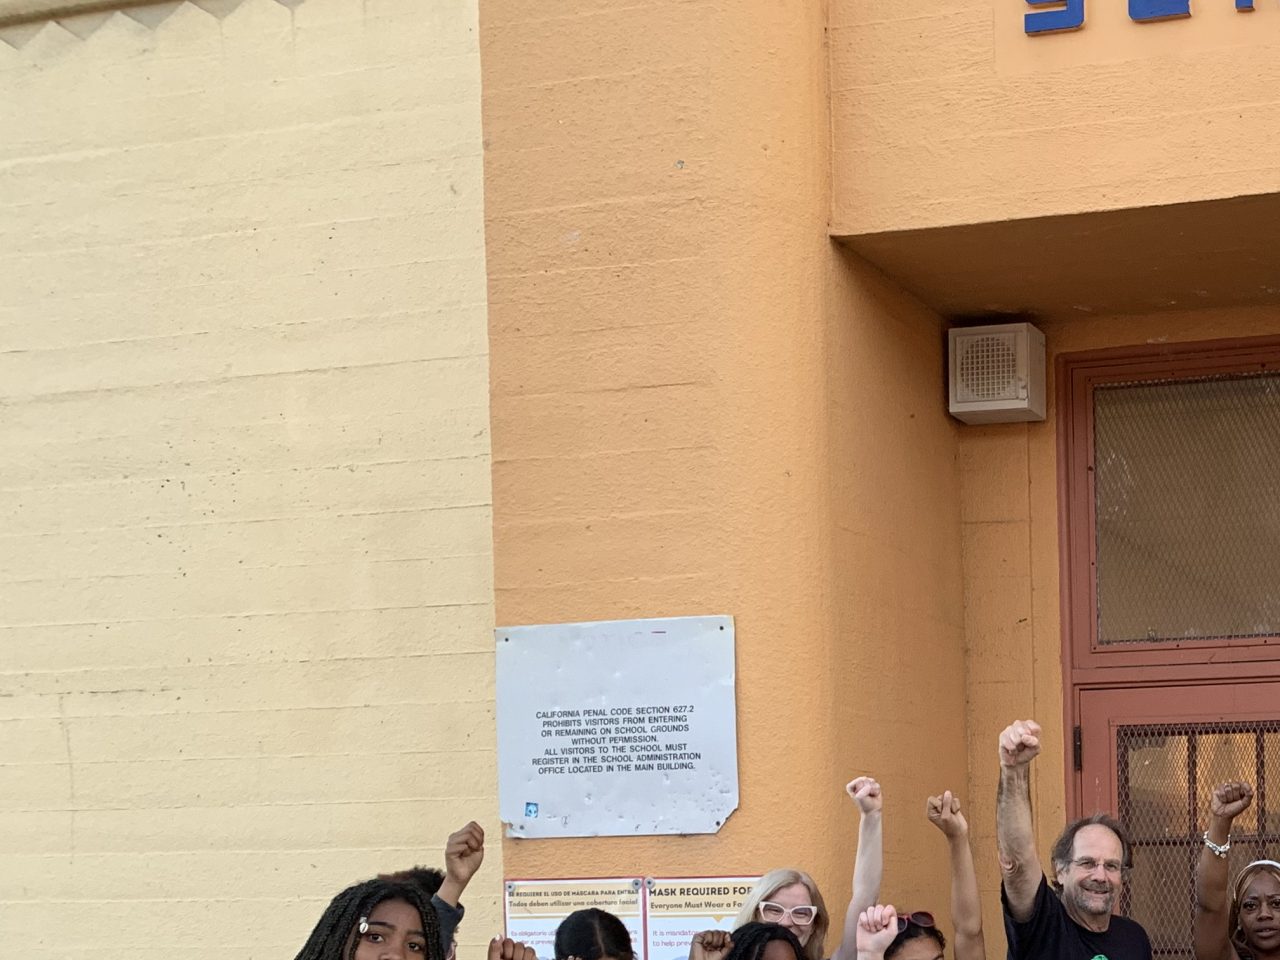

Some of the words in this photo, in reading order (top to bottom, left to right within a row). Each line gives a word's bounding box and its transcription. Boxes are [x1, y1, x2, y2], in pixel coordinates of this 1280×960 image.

[536, 710, 580, 718] CALIFORNIA
[583, 709, 607, 717] PENAL
[636, 706, 669, 715] SECTION
[673, 705, 694, 713] 627.2
[543, 719, 581, 727] PROHIBITS
[585, 718, 619, 726] VISITORS
[649, 715, 687, 723] ENTERING
[555, 727, 596, 736] REMAINING
[615, 726, 647, 734] SCHOOL
[651, 724, 689, 732] GROUNDS
[609, 735, 659, 743] PERMISSION.
[630, 744, 662, 752] SCHOOL
[636, 753, 701, 761] ADMINISTRATION
[657, 762, 695, 770] BUILDING.
[649, 888, 676, 896] MASK
[680, 887, 729, 896] REQUIRED
[651, 902, 682, 910] Everyone
